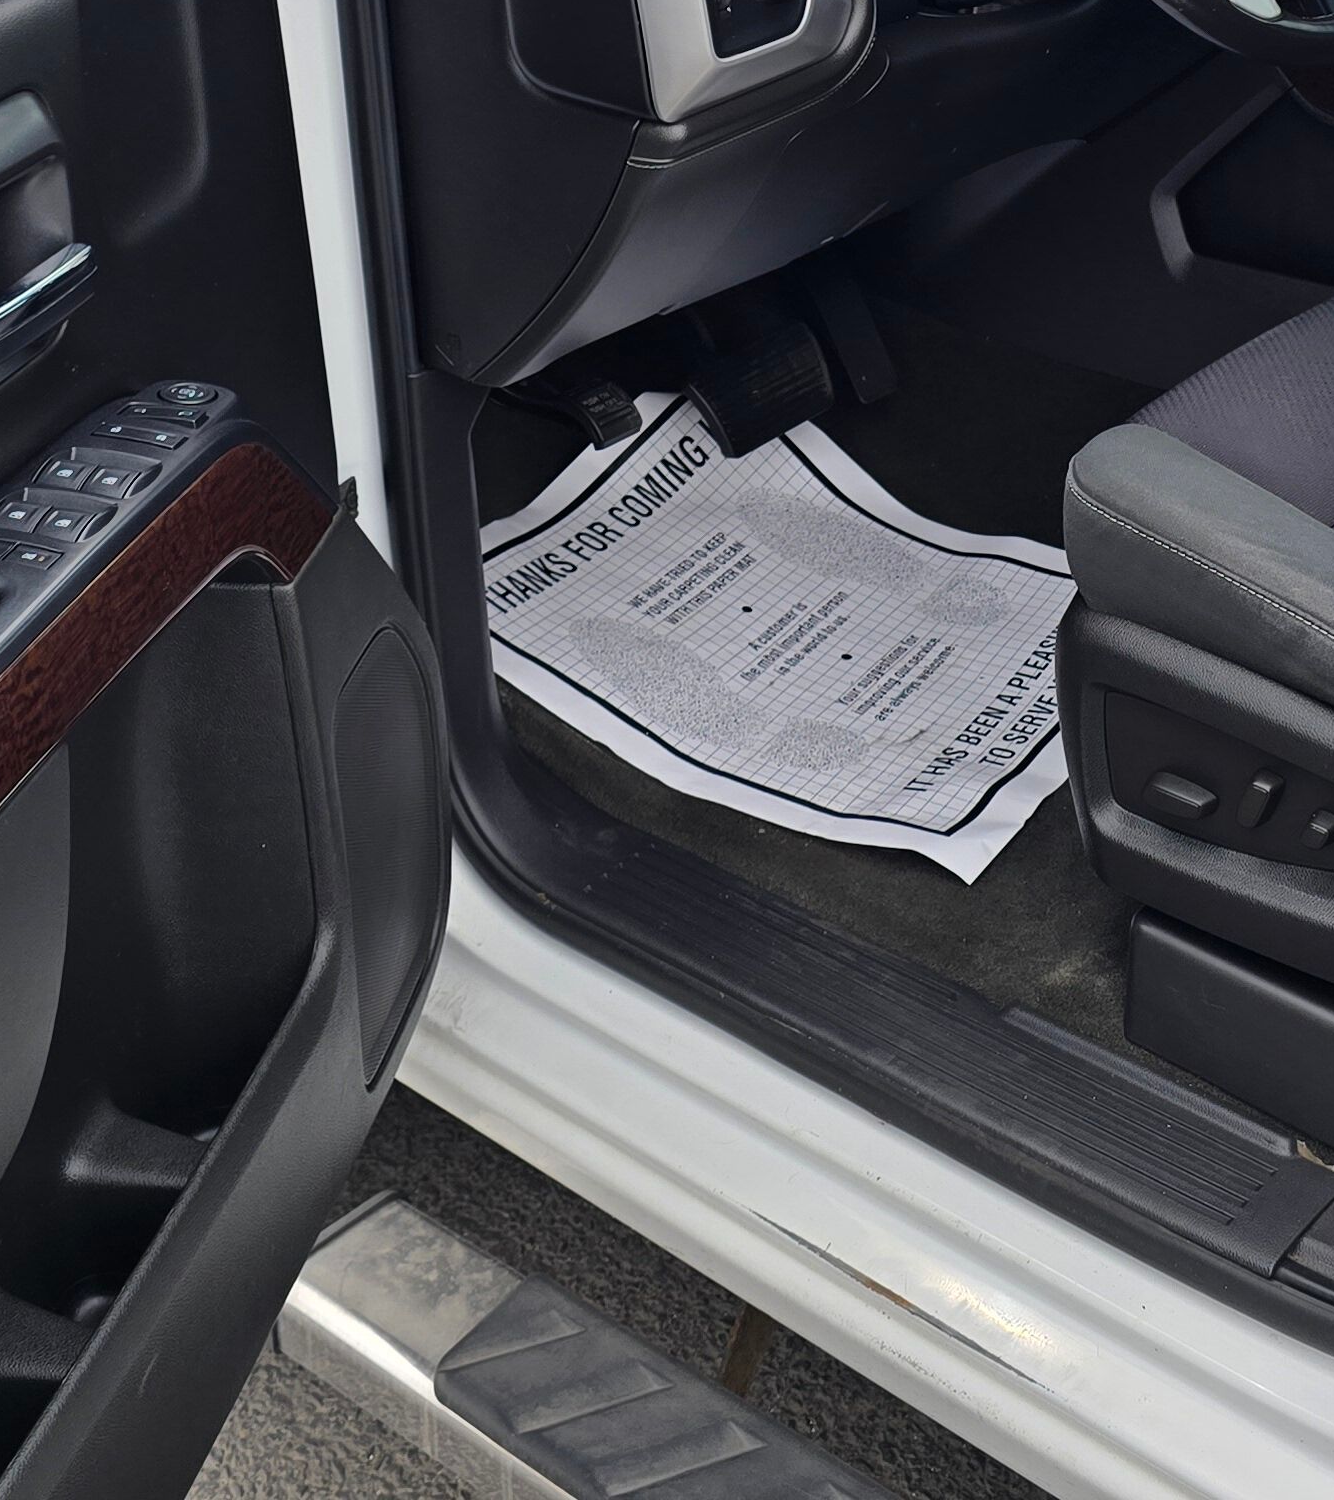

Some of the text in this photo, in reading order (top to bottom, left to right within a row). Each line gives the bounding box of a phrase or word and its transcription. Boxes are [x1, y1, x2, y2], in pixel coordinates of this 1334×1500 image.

[561, 521, 624, 561] FOR
[608, 435, 710, 528] COMING
[629, 532, 727, 608] WE HAVE TRIED TO KEEP
[642, 541, 746, 618] YOUR CARPETING CLEAN
[665, 553, 757, 625] WITH THIS PAPER MAT
[740, 591, 850, 681] the most important person
[748, 641, 763, 651] A
[757, 610, 799, 645] customer
[784, 653, 805, 667] the
[801, 632, 828, 655] world
[820, 625, 837, 634] to
[857, 645, 908, 688] suggestions
[894, 664, 913, 679] our
[874, 707, 894, 722] are
[903, 777, 934, 792] IT
[921, 747, 969, 775] HAS
[955, 706, 1010, 746] BEEN
[996, 694, 1023, 706] A
[979, 694, 1058, 767] TO SERVE
